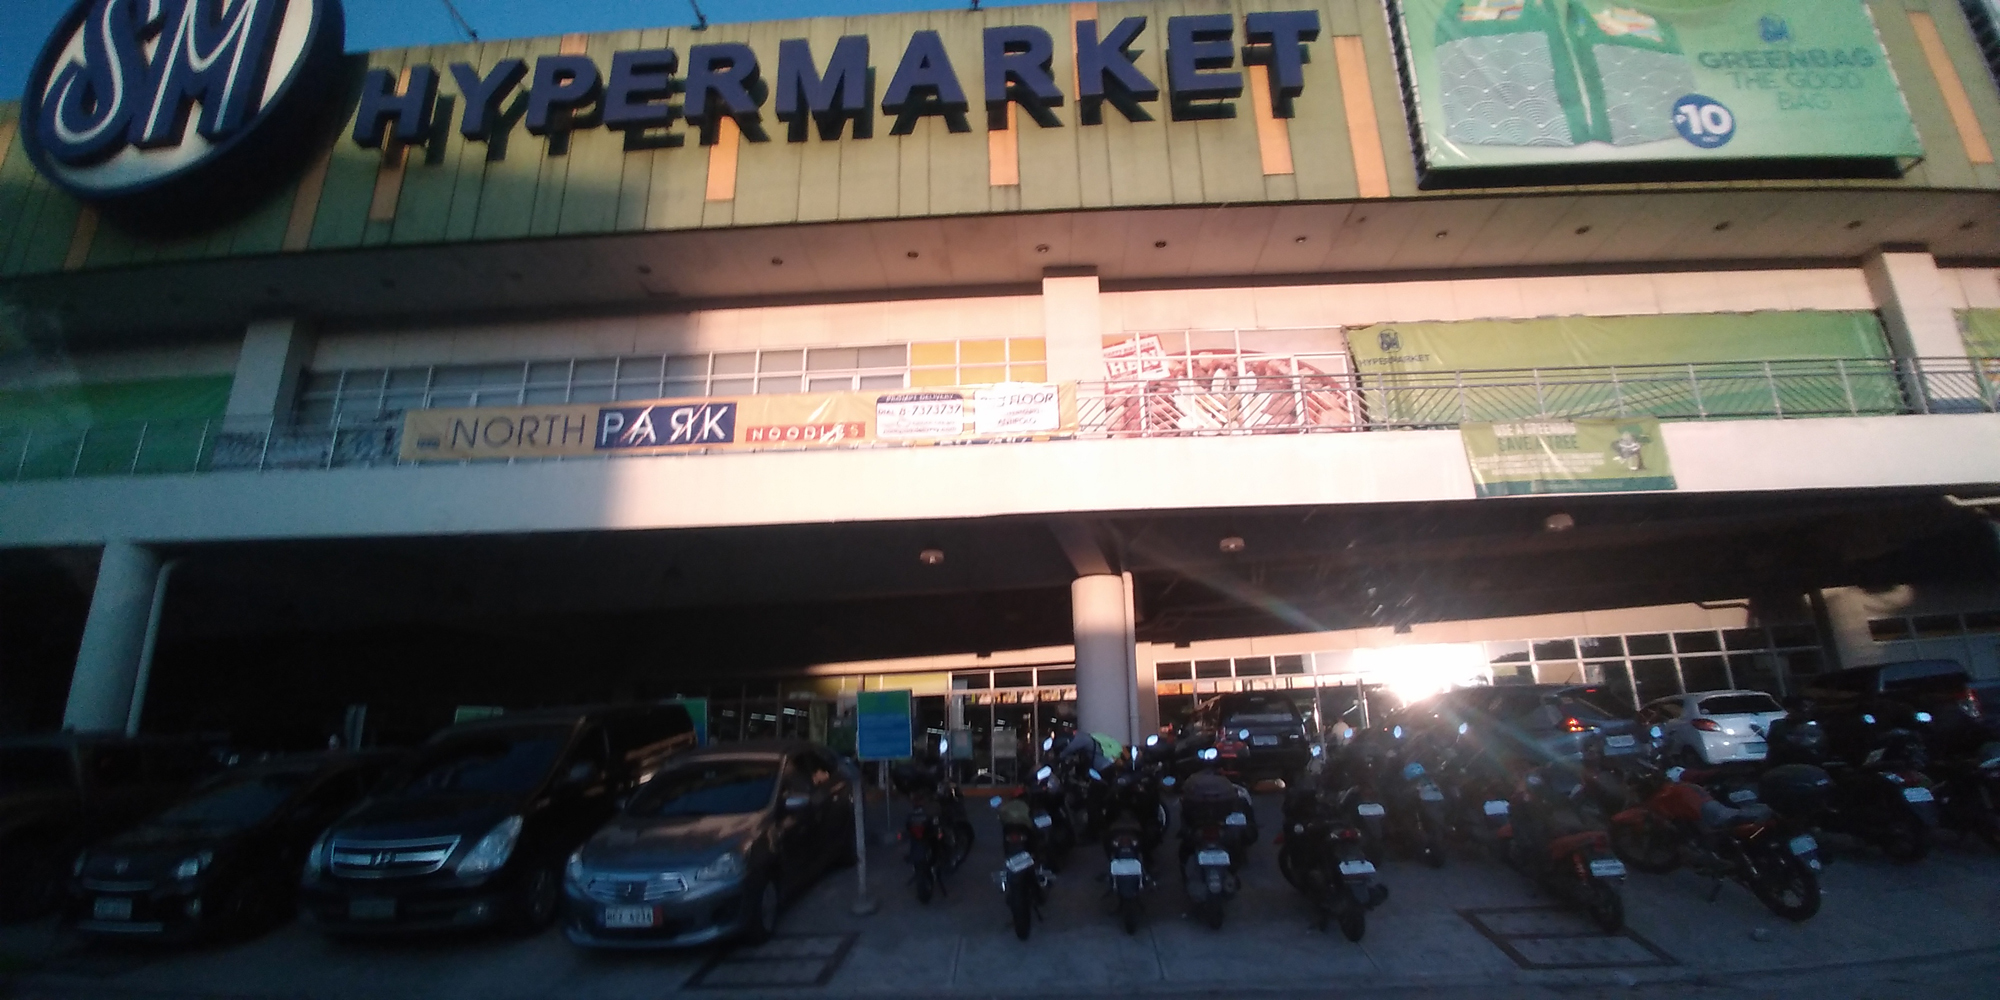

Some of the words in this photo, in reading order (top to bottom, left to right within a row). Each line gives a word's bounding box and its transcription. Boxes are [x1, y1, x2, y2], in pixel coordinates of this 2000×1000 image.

[1698, 47, 1876, 69] GREENBAG
[38, 0, 275, 167] SM
[351, 9, 1320, 148] HYPERMARKET
[1727, 71, 1780, 89] THE
[1786, 69, 1864, 89] GOOD
[1778, 90, 1832, 110] BAG
[1361, 353, 1430, 367] HYPERMARKET
[1009, 392, 1054, 406] FLOOR
[451, 414, 586, 449] NORTH
